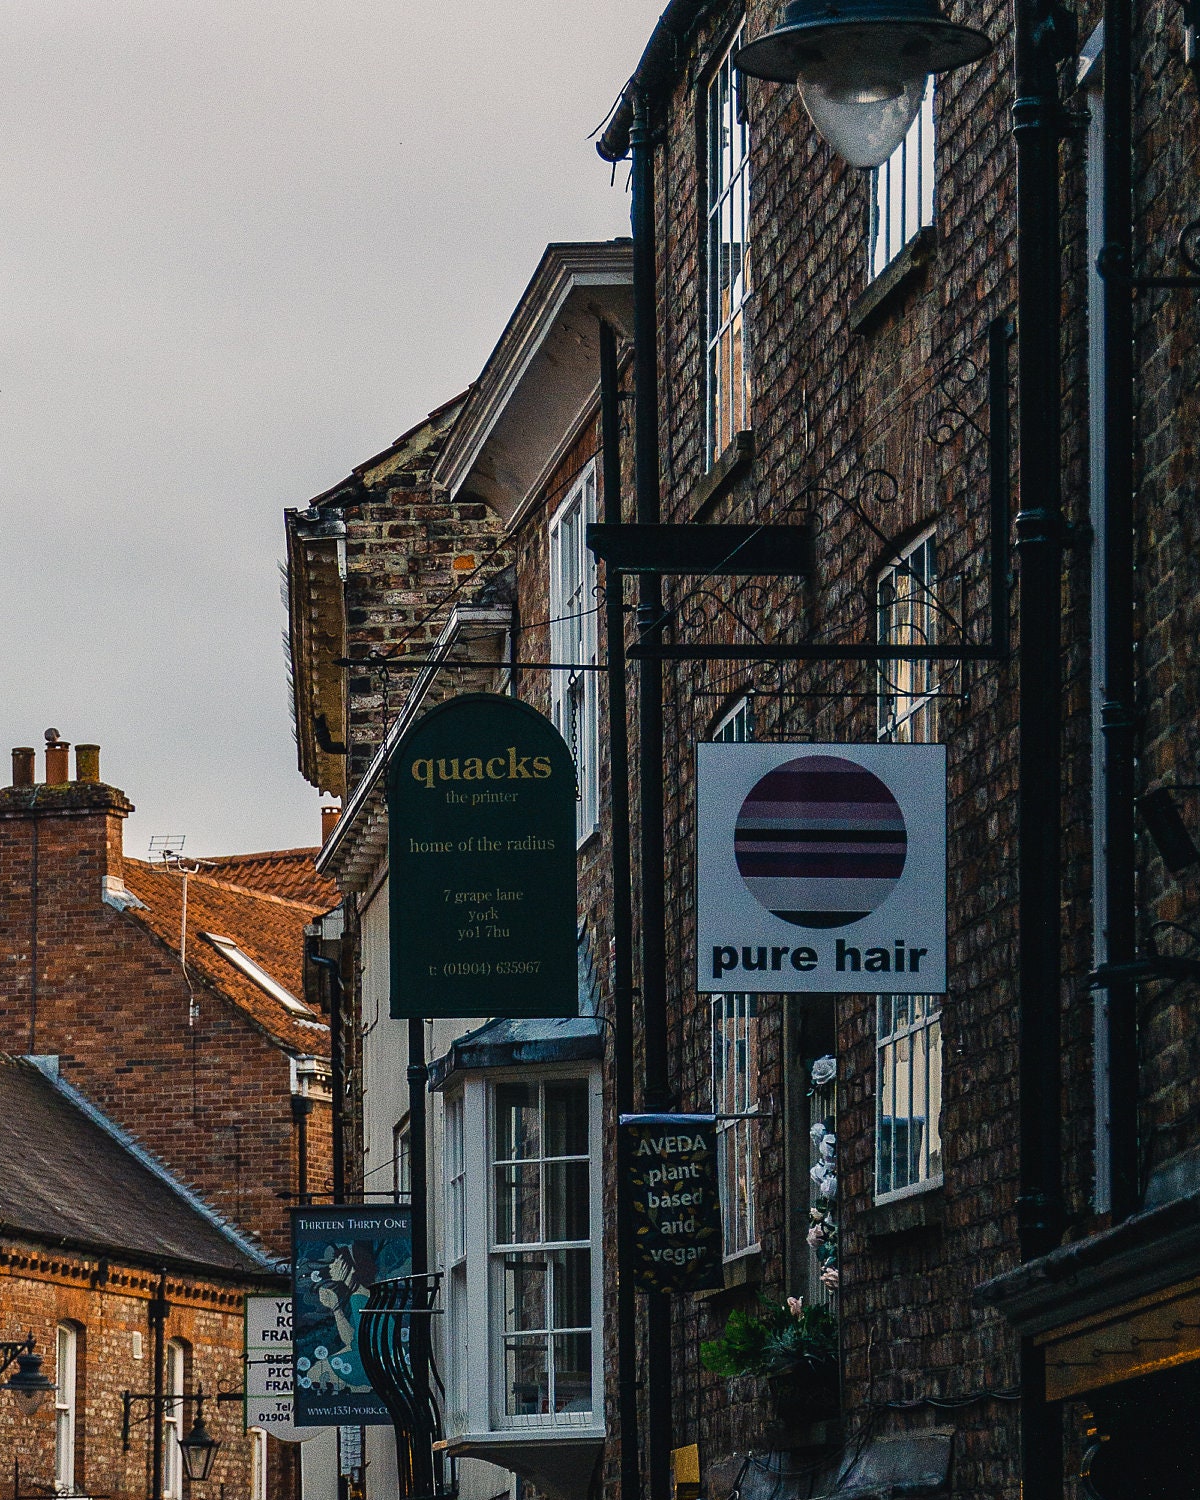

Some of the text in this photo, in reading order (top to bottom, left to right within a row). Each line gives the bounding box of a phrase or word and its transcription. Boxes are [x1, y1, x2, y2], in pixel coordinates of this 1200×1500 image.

[411, 746, 552, 789] quacks
[446, 789, 519, 806] the printer
[409, 835, 556, 853] home of the radius
[443, 888, 524, 904] 7 grape lane
[468, 906, 499, 923] york
[712, 939, 928, 979] pure hair
[443, 962, 491, 977] (01904)
[496, 961, 542, 974] 635967
[637, 1134, 707, 1156] AVEDA
[649, 1162, 700, 1187] plant
[647, 1188, 703, 1209] based
[660, 1216, 695, 1235] and
[650, 1245, 708, 1266] vegan
[261, 1330, 293, 1341] FRA
[265, 1380, 293, 1391] FRA
[258, 1413, 291, 1422] 01904
